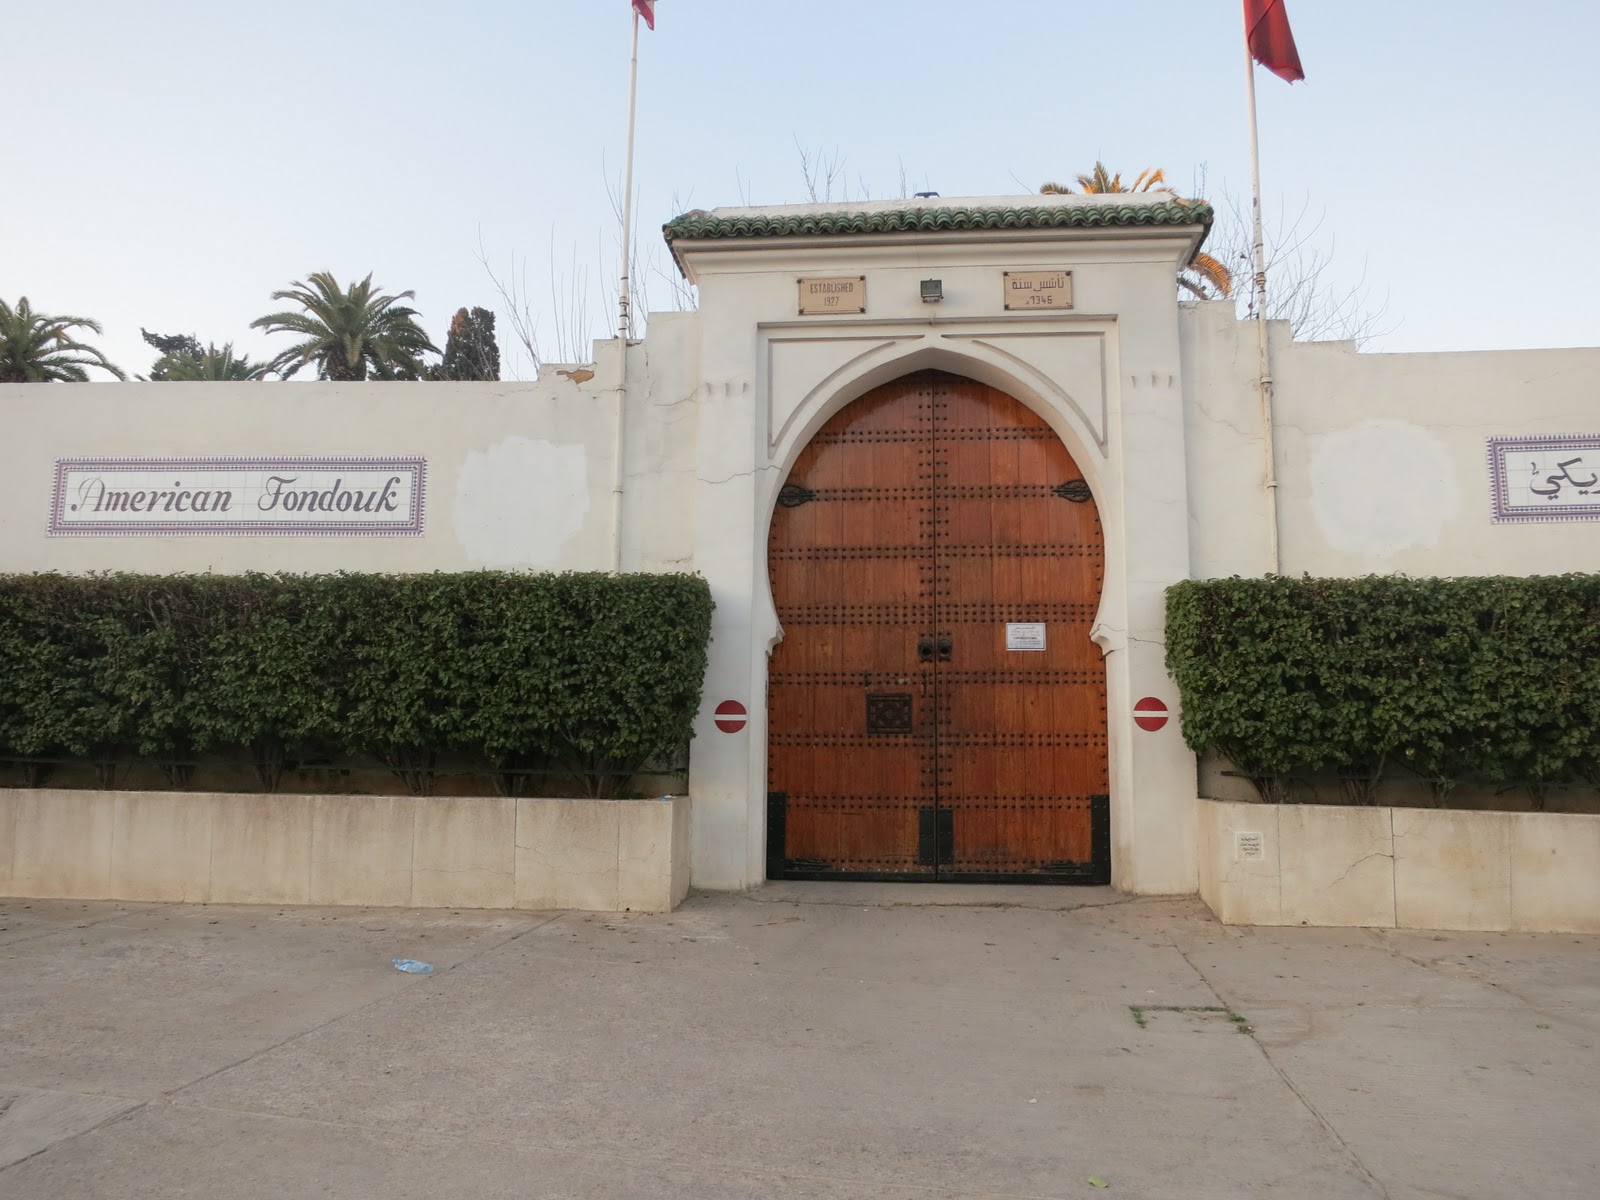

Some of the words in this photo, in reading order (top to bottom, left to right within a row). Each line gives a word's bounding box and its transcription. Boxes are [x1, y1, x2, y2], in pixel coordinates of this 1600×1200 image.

[810, 282, 854, 294] ESTABLISHED
[1012, 278, 1032, 290] سنة
[823, 296, 840, 307] 1927
[70, 475, 233, 513] American
[256, 474, 401, 513] Fondouk
